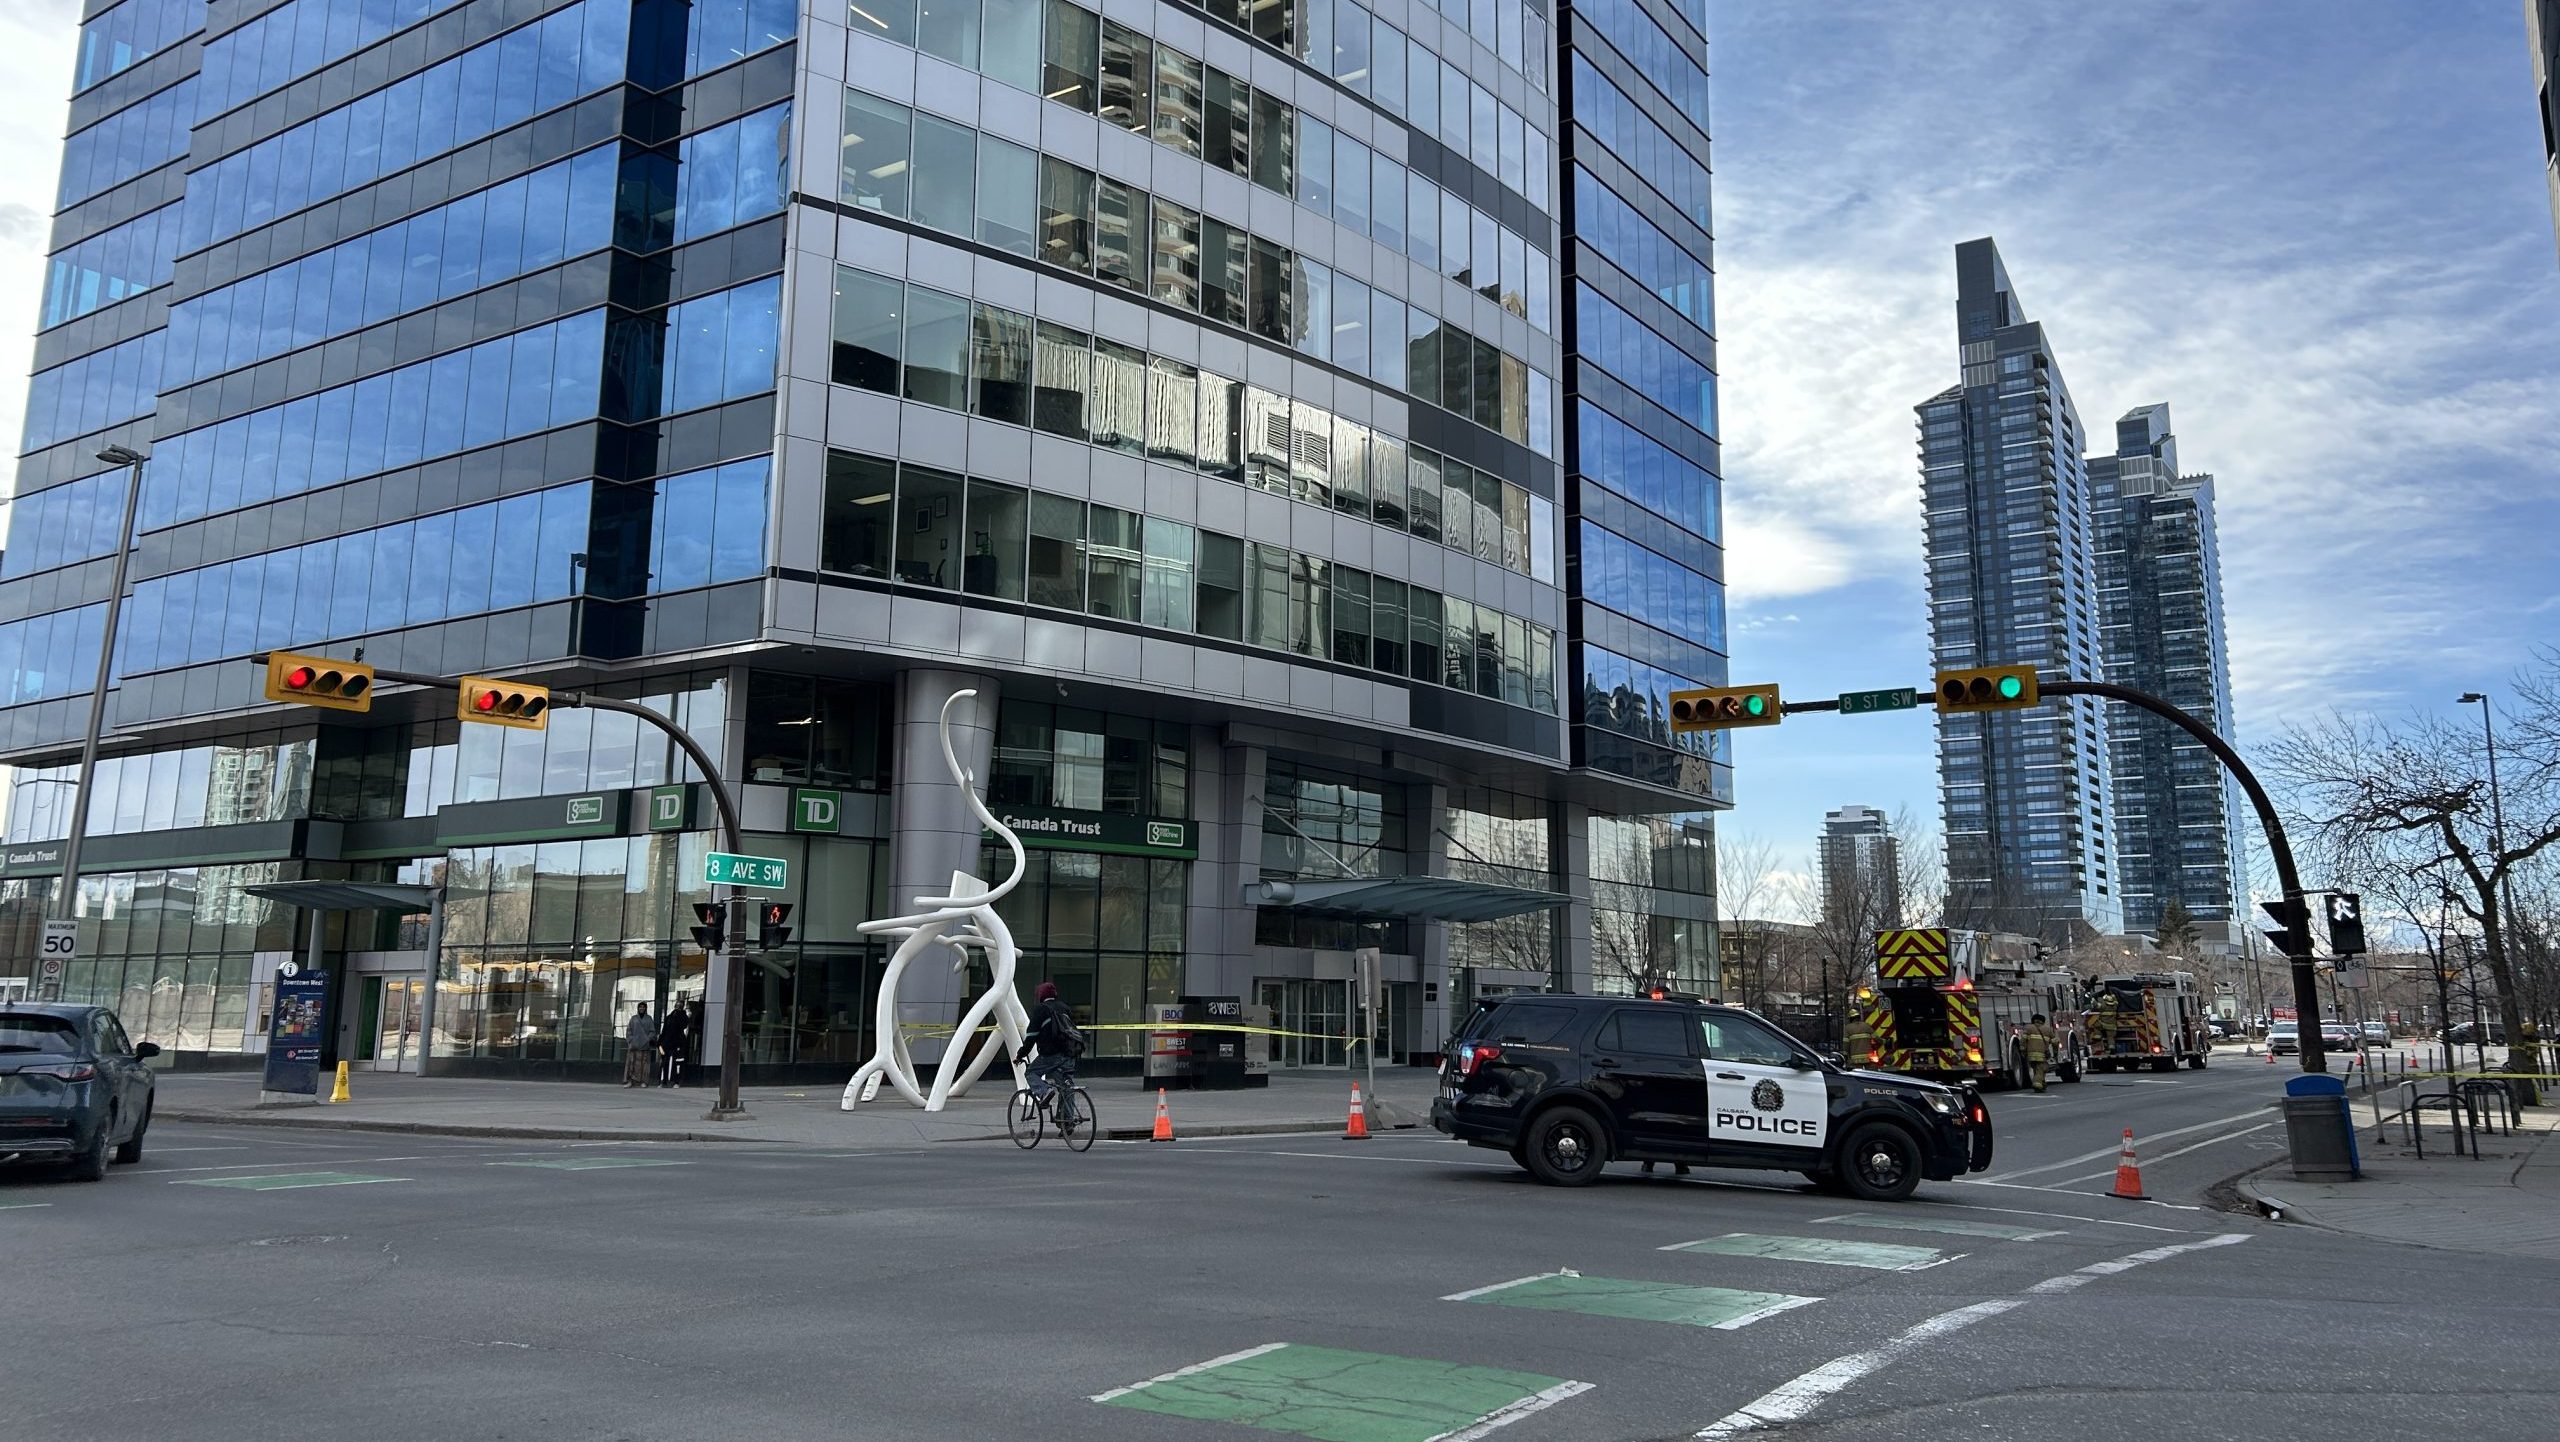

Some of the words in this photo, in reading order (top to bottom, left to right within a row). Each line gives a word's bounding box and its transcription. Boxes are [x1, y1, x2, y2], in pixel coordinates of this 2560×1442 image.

[1844, 697, 1852, 710] 8
[1863, 695, 1879, 709] ST
[1892, 691, 1911, 706] SW
[656, 795, 680, 820] TD
[801, 797, 835, 823] TD
[1002, 815, 1058, 831] Canada
[1061, 819, 1101, 835] Trust
[9, 851, 36, 863] Canada
[36, 850, 57, 862] Trust
[710, 860, 720, 876] 8
[731, 861, 757, 879] AVE
[763, 865, 782, 881] SW
[44, 936, 74, 953] 50
[1863, 1088, 1898, 1096] POLICE
[1716, 1113, 1817, 1136] POLICE
